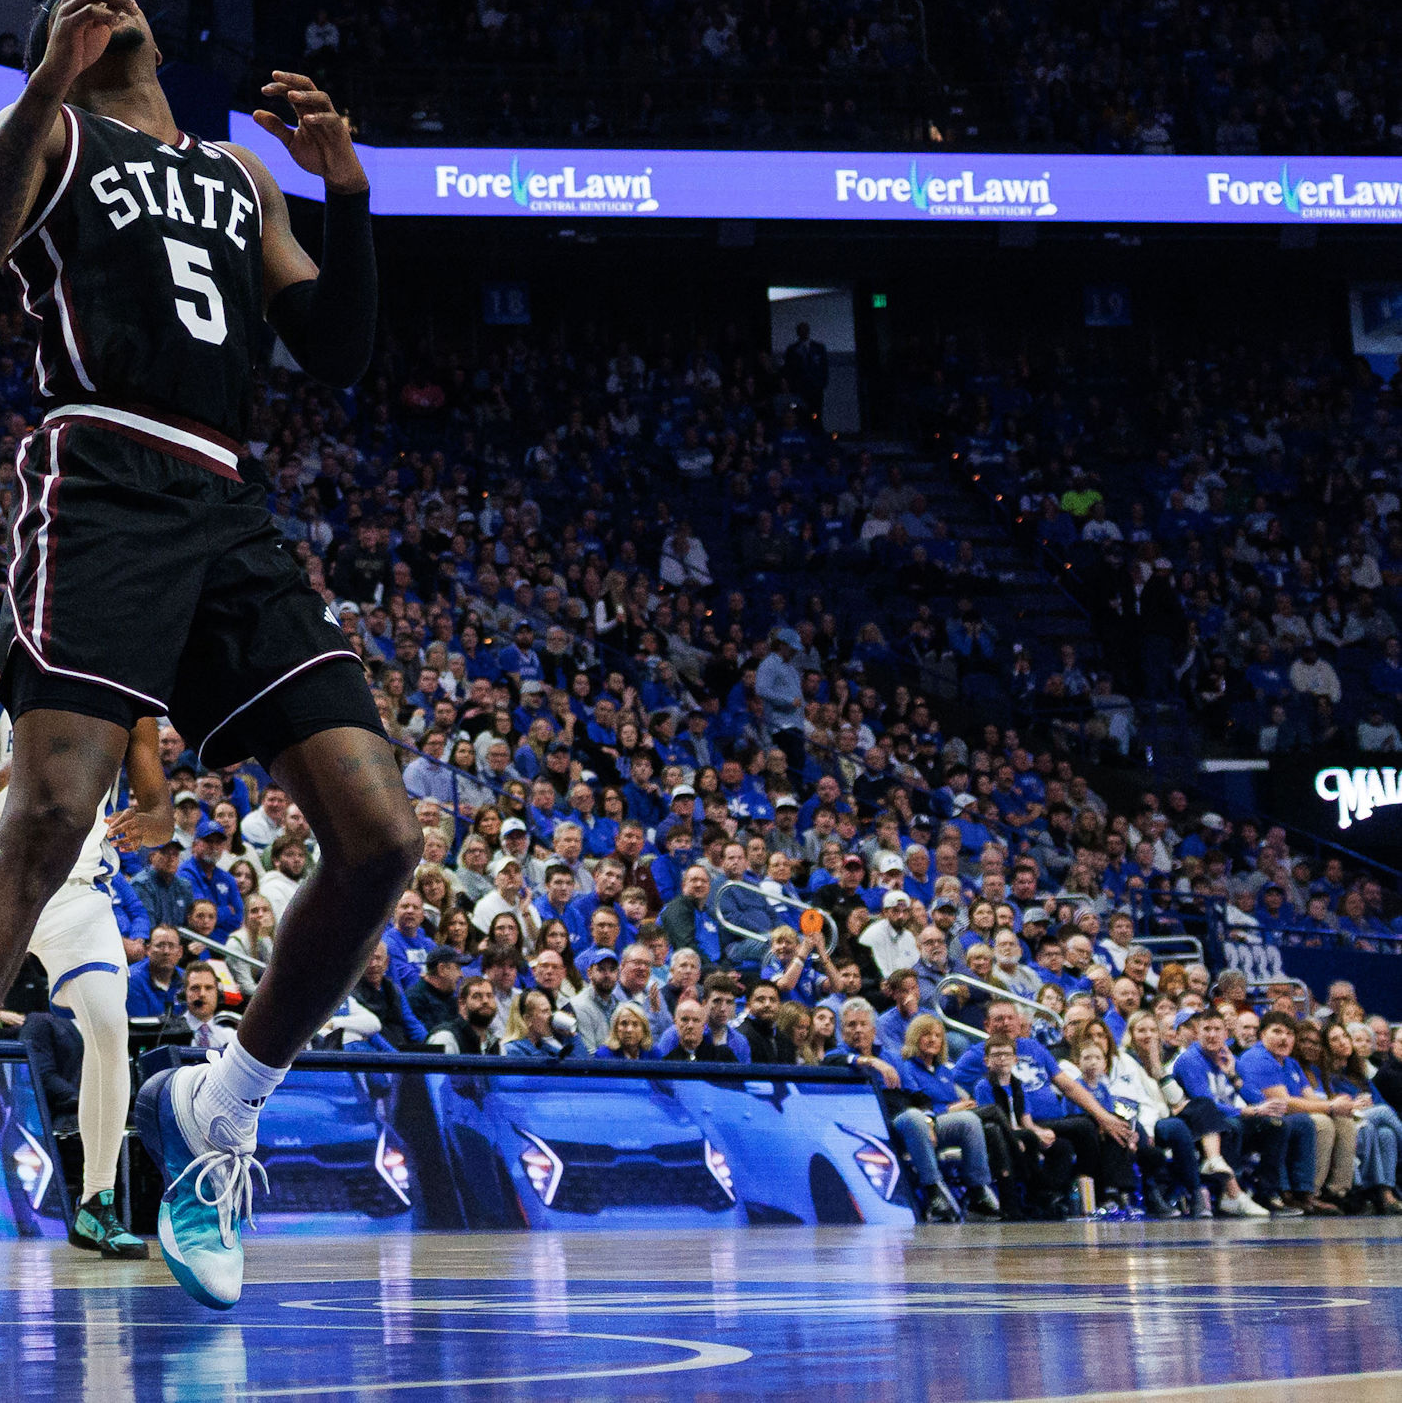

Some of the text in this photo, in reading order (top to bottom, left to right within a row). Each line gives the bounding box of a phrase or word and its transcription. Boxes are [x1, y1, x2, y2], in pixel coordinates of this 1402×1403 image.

[90, 161, 254, 251] STATE
[530, 200, 635, 213] CENTRAL KENTUCKY
[163, 236, 228, 346] 5
